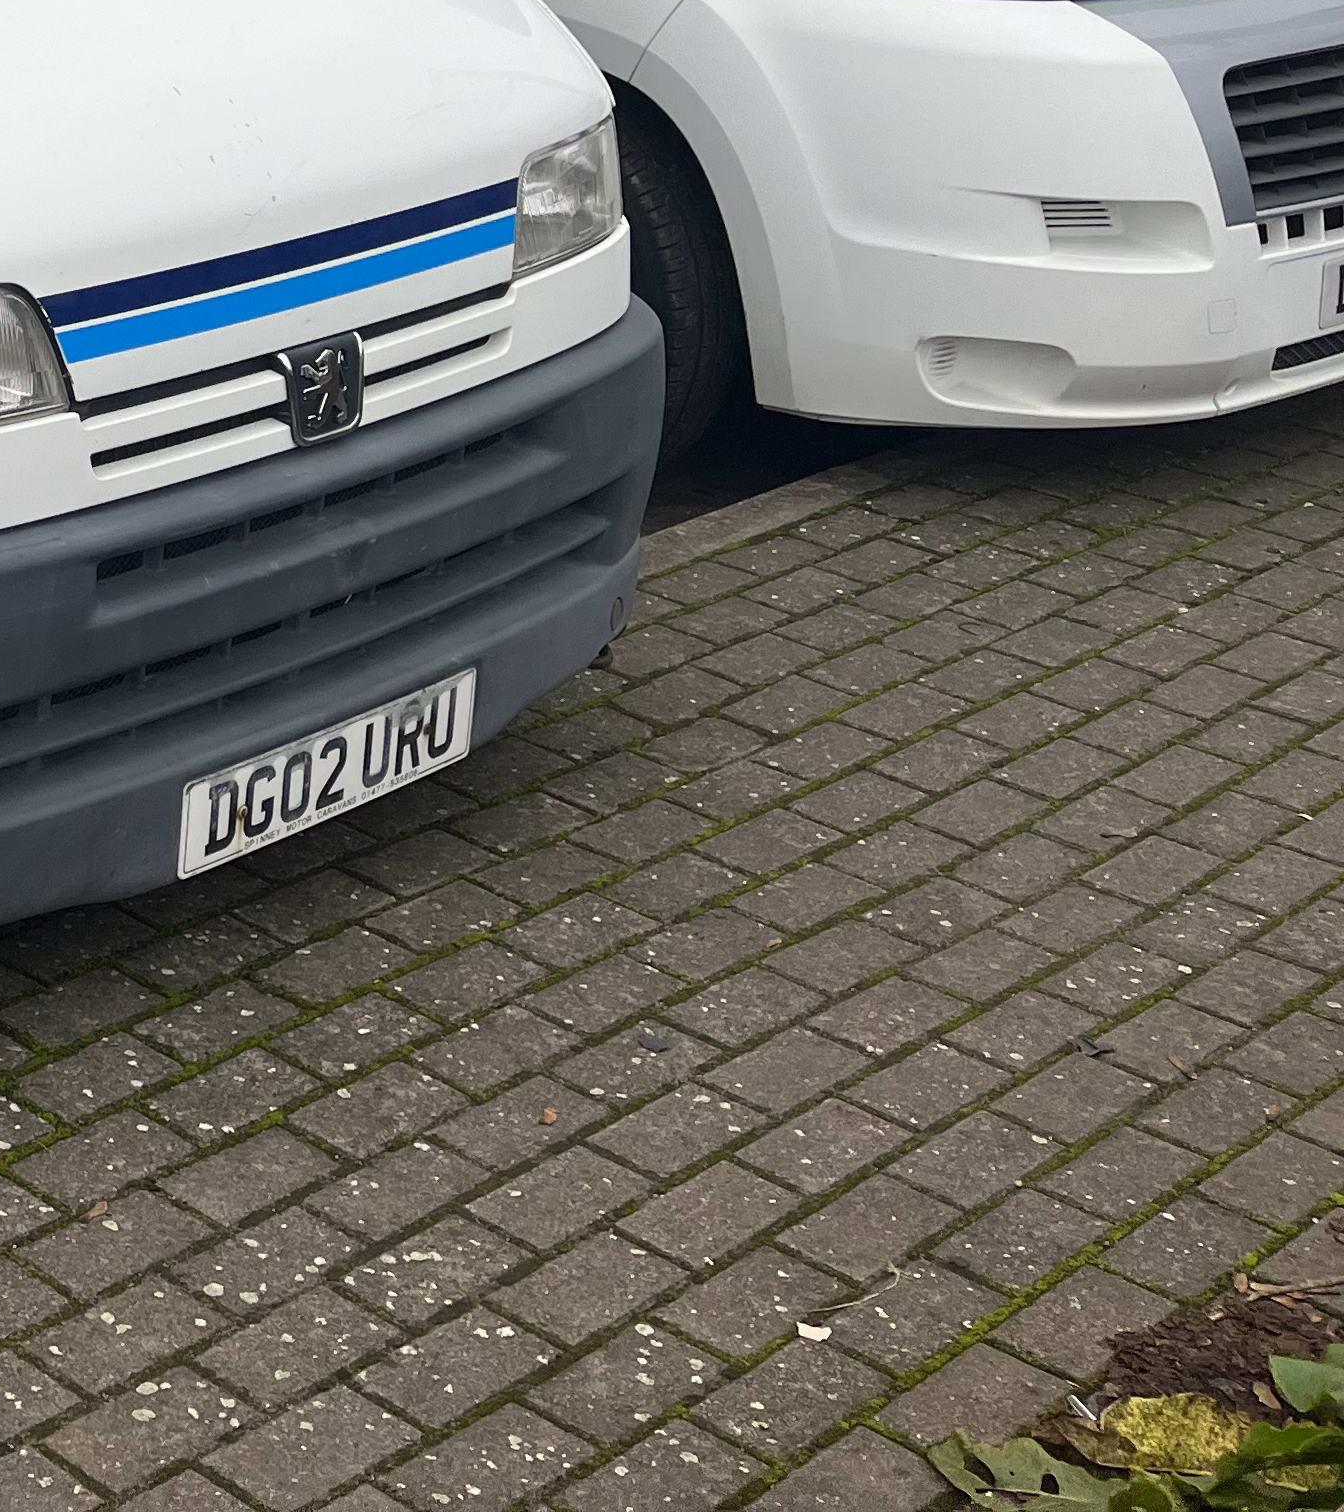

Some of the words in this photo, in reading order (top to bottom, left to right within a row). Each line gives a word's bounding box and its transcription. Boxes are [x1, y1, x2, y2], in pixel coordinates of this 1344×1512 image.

[204, 736, 347, 857] DG02
[362, 687, 458, 789] URU
[286, 815, 313, 833] MOTOR
[316, 796, 358, 820] CARAVANS
